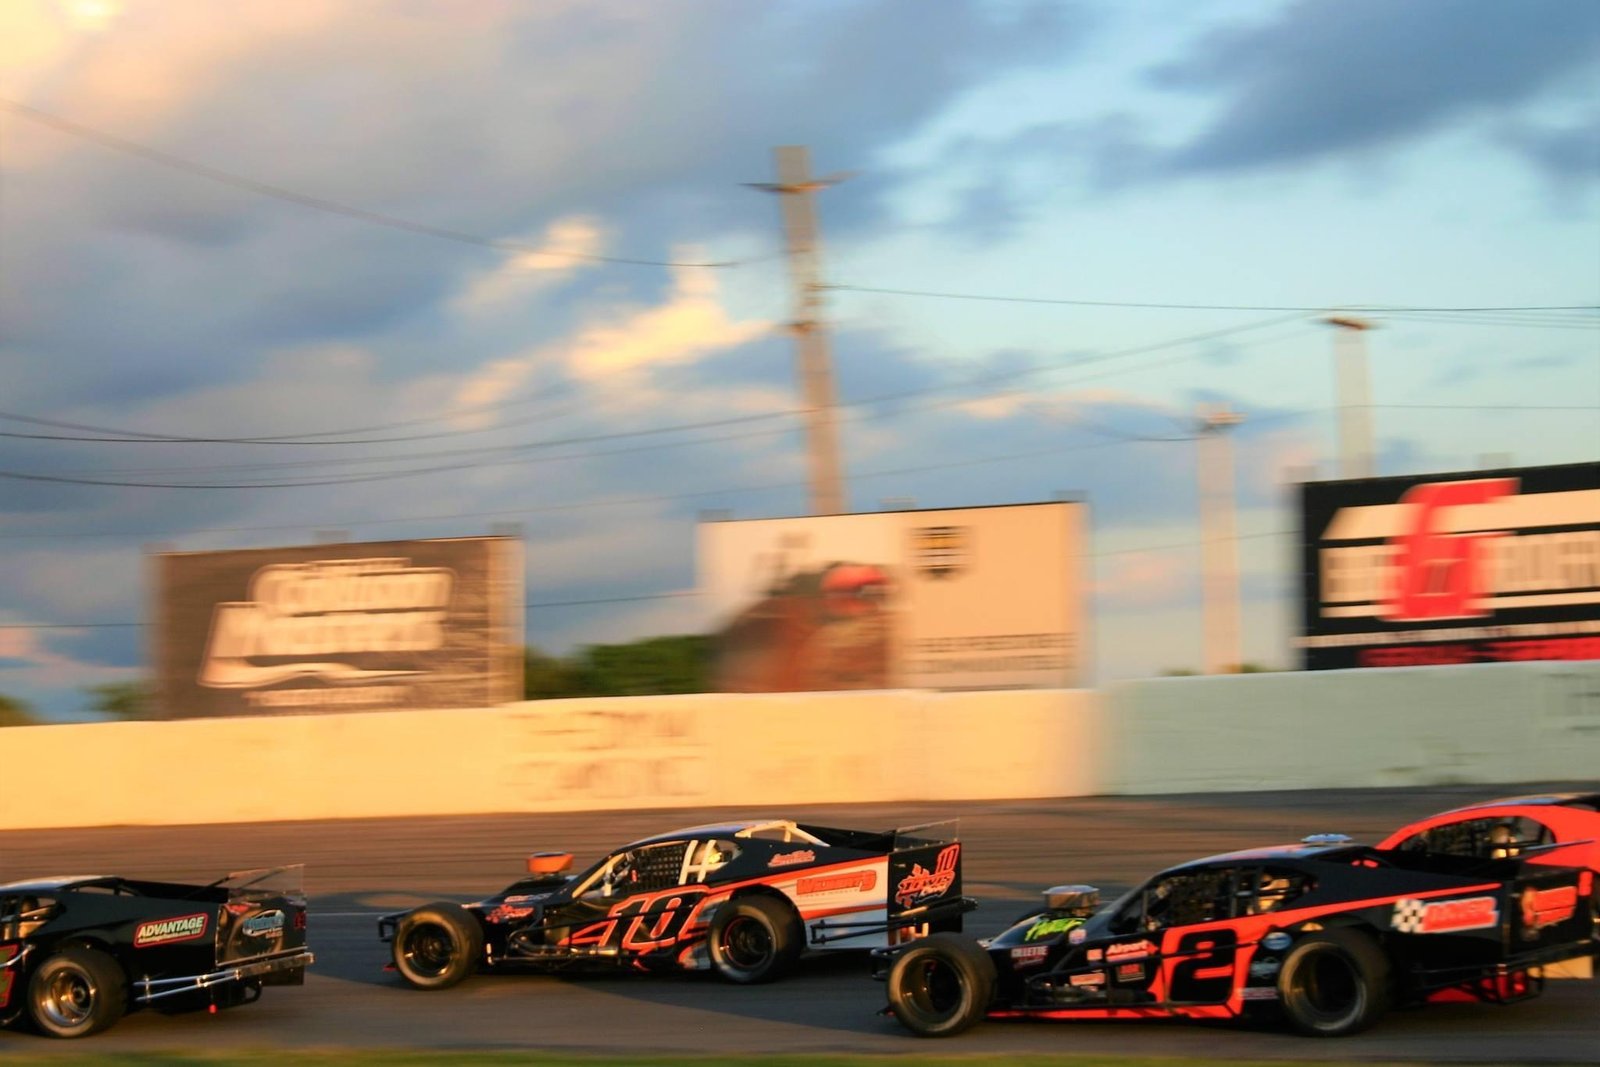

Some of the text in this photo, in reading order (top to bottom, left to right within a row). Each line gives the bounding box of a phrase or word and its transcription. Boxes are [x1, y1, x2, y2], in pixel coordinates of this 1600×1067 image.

[935, 844, 960, 875] 10
[138, 916, 204, 938] ADVANTAGE
[1169, 928, 1237, 1002] 2
